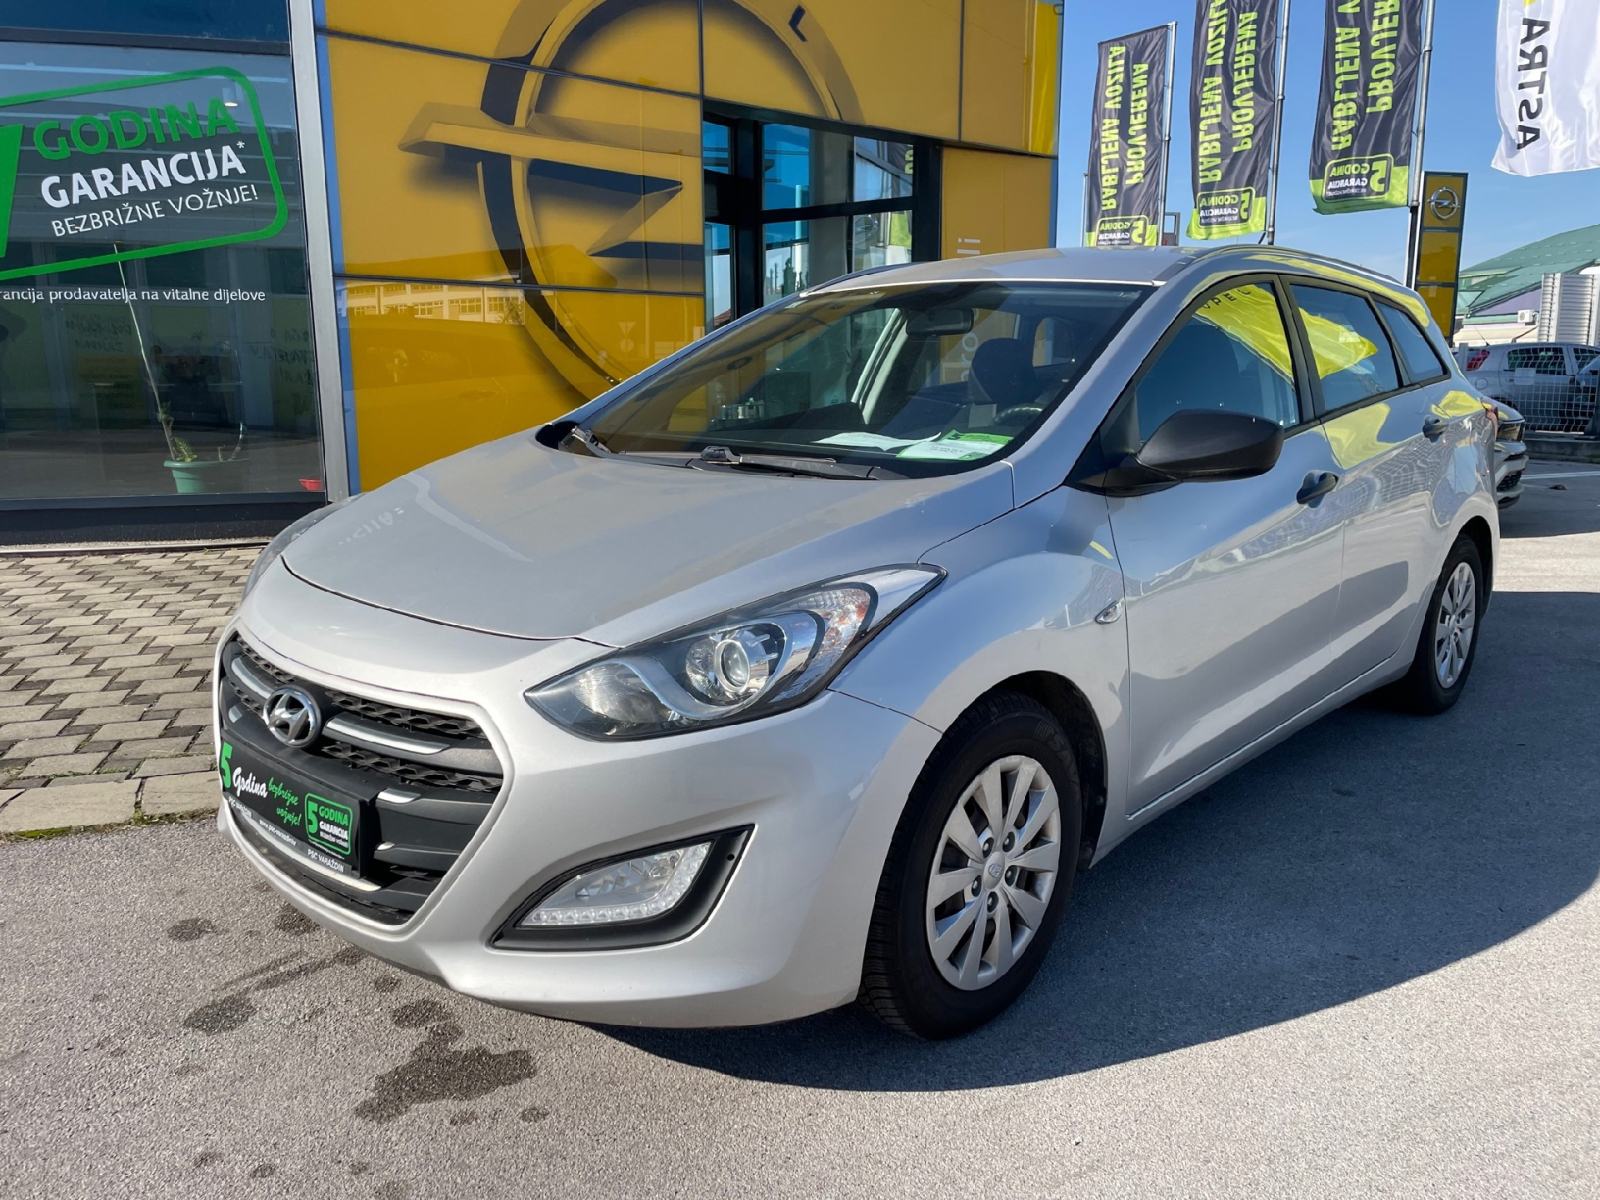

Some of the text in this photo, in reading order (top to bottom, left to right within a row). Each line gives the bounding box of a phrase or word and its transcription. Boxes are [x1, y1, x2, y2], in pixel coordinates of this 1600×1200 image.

[33, 97, 240, 160] GODINA
[52, 183, 259, 237] BEZBRIŽNE VOŽNJE!
[49, 287, 138, 303] prodavatelja
[141, 291, 159, 300] na
[163, 288, 209, 300] vitalne
[214, 288, 266, 304] dijelove
[221, 741, 233, 789] 5
[232, 766, 268, 798] Godina
[307, 800, 318, 834] 5
[319, 805, 349, 826] GODINA
